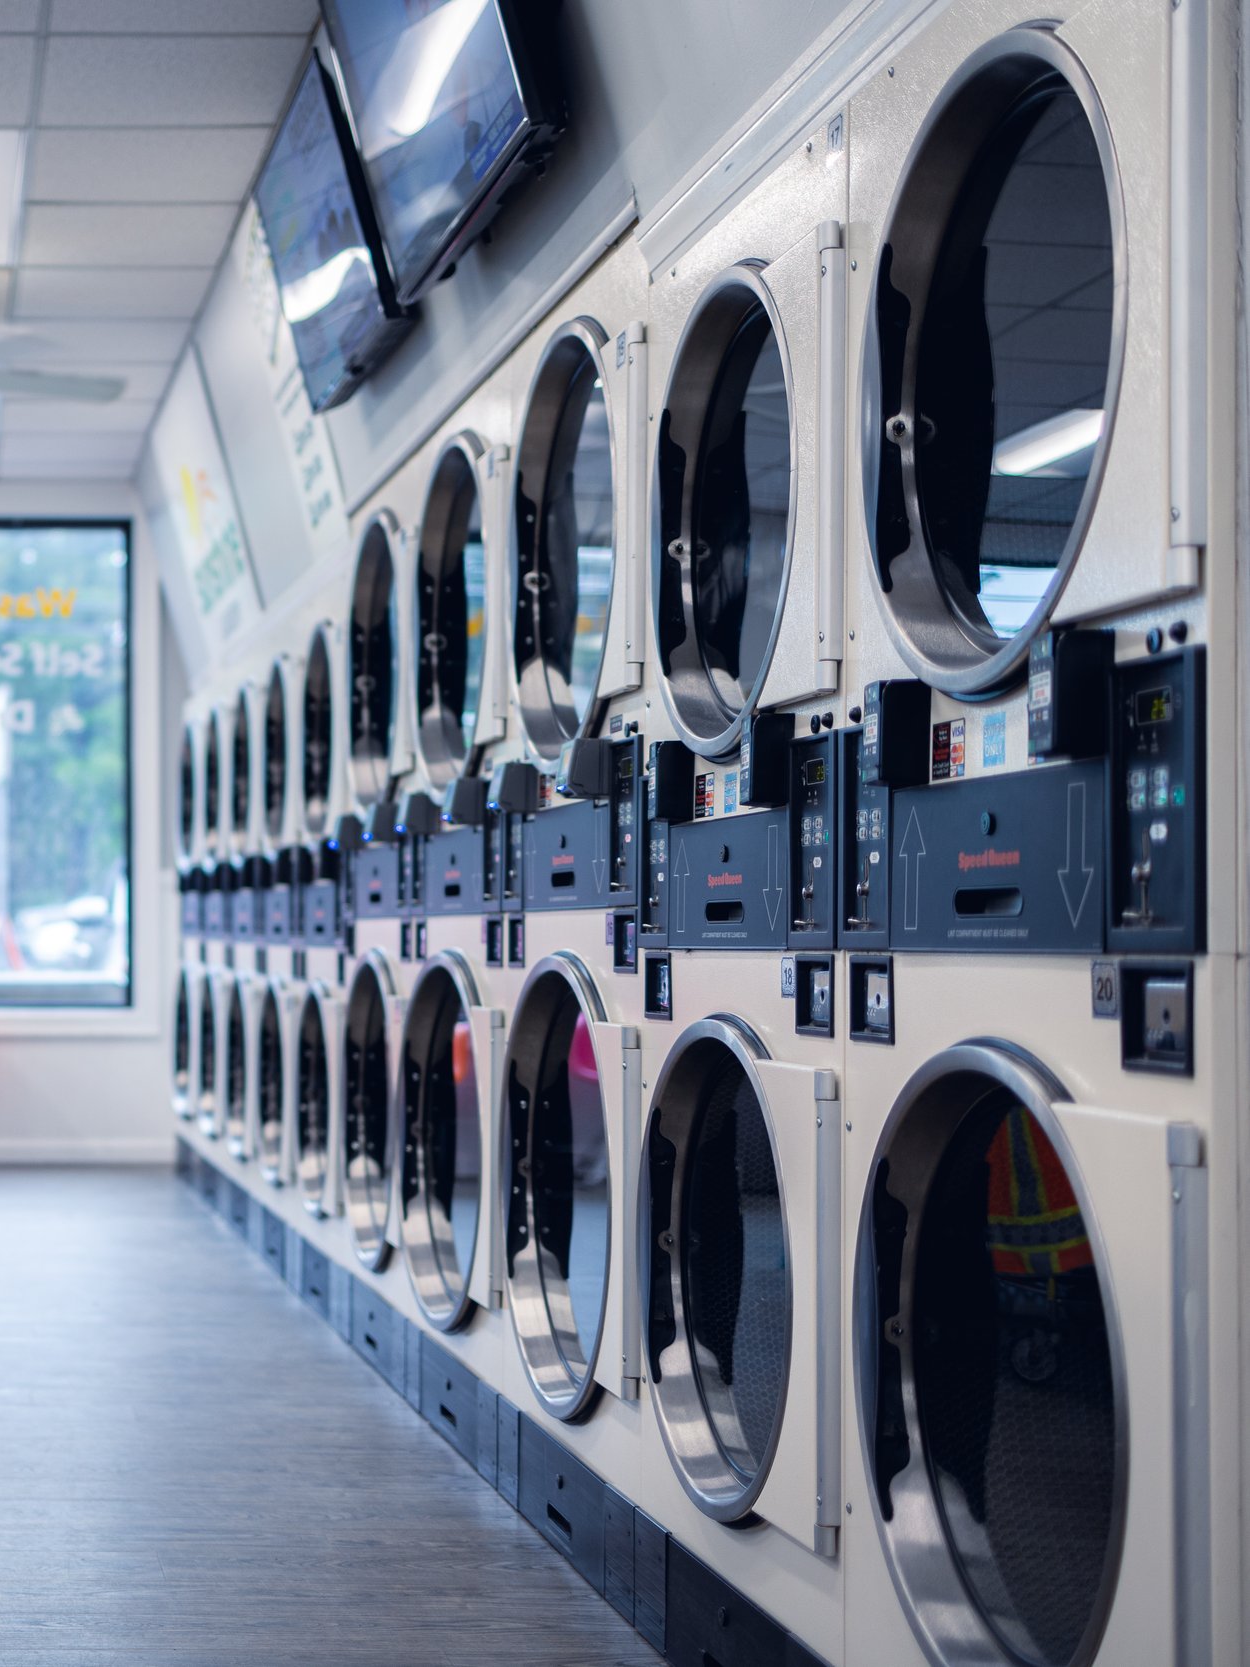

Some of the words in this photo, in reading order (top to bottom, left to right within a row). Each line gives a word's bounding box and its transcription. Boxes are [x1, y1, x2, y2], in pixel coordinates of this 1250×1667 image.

[830, 125, 840, 148] 17
[952, 726, 965, 738] VISA
[984, 742, 1004, 758] ONLY
[958, 849, 988, 872] Speed
[989, 847, 1020, 866] Queen
[707, 873, 724, 889] Speed
[725, 872, 743, 885] Queen
[784, 967, 792, 986] 18
[1096, 977, 1113, 1001] 20
